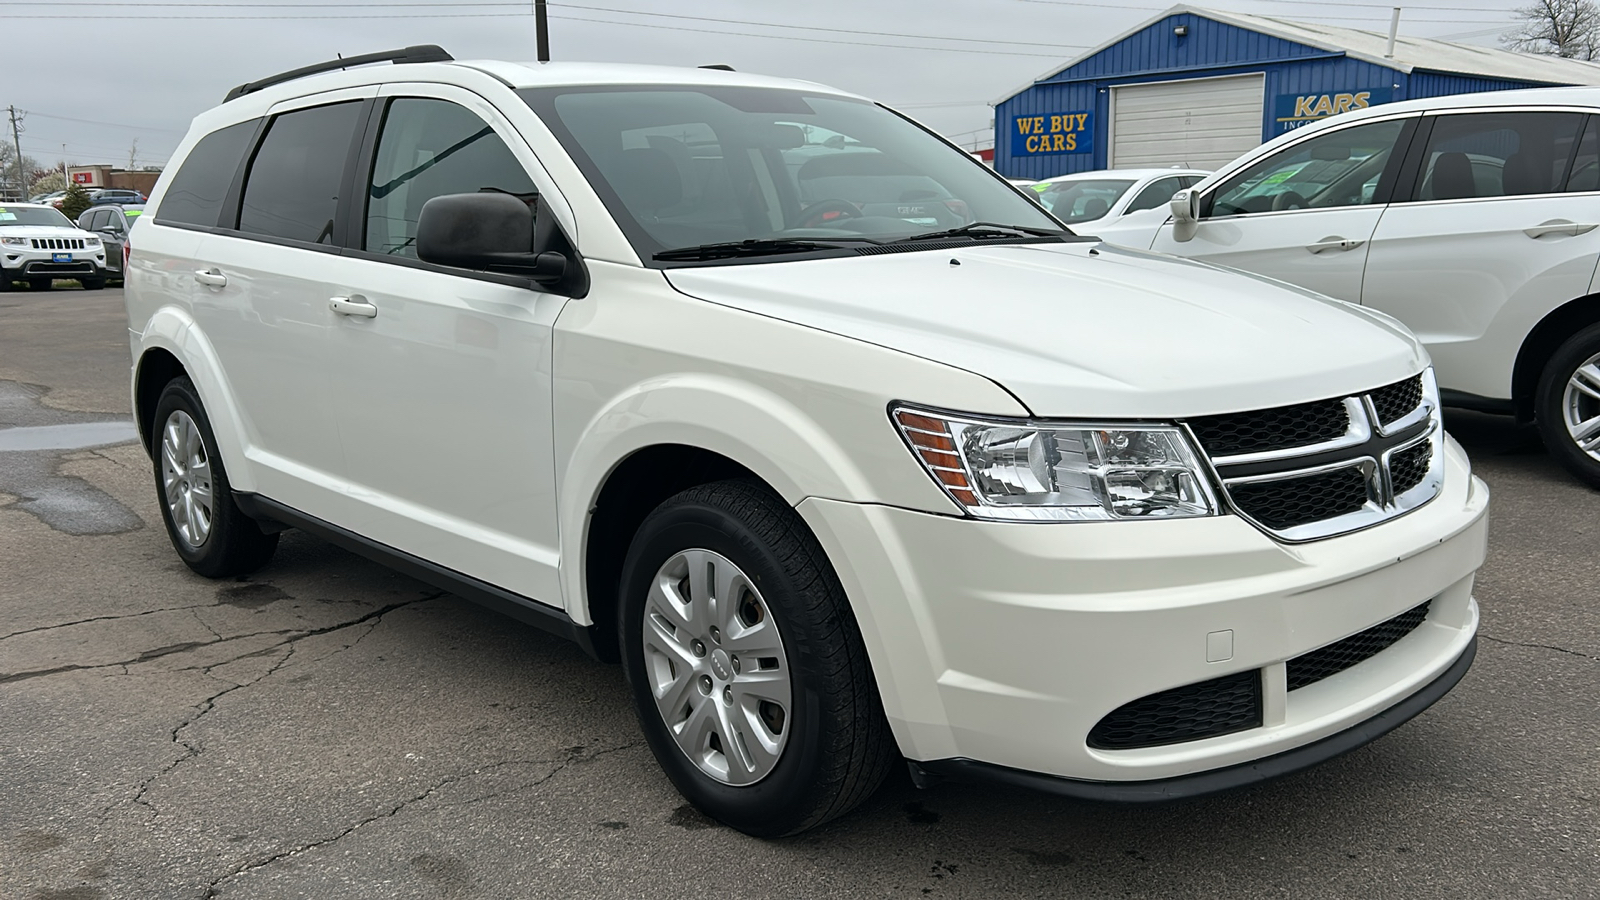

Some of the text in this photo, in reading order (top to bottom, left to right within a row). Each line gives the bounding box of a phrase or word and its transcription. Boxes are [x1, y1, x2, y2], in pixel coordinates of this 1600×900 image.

[1294, 91, 1371, 117] KARS
[1016, 113, 1088, 135] WE BUY
[1026, 133, 1077, 153] CARS
[897, 206, 925, 214] GMC
